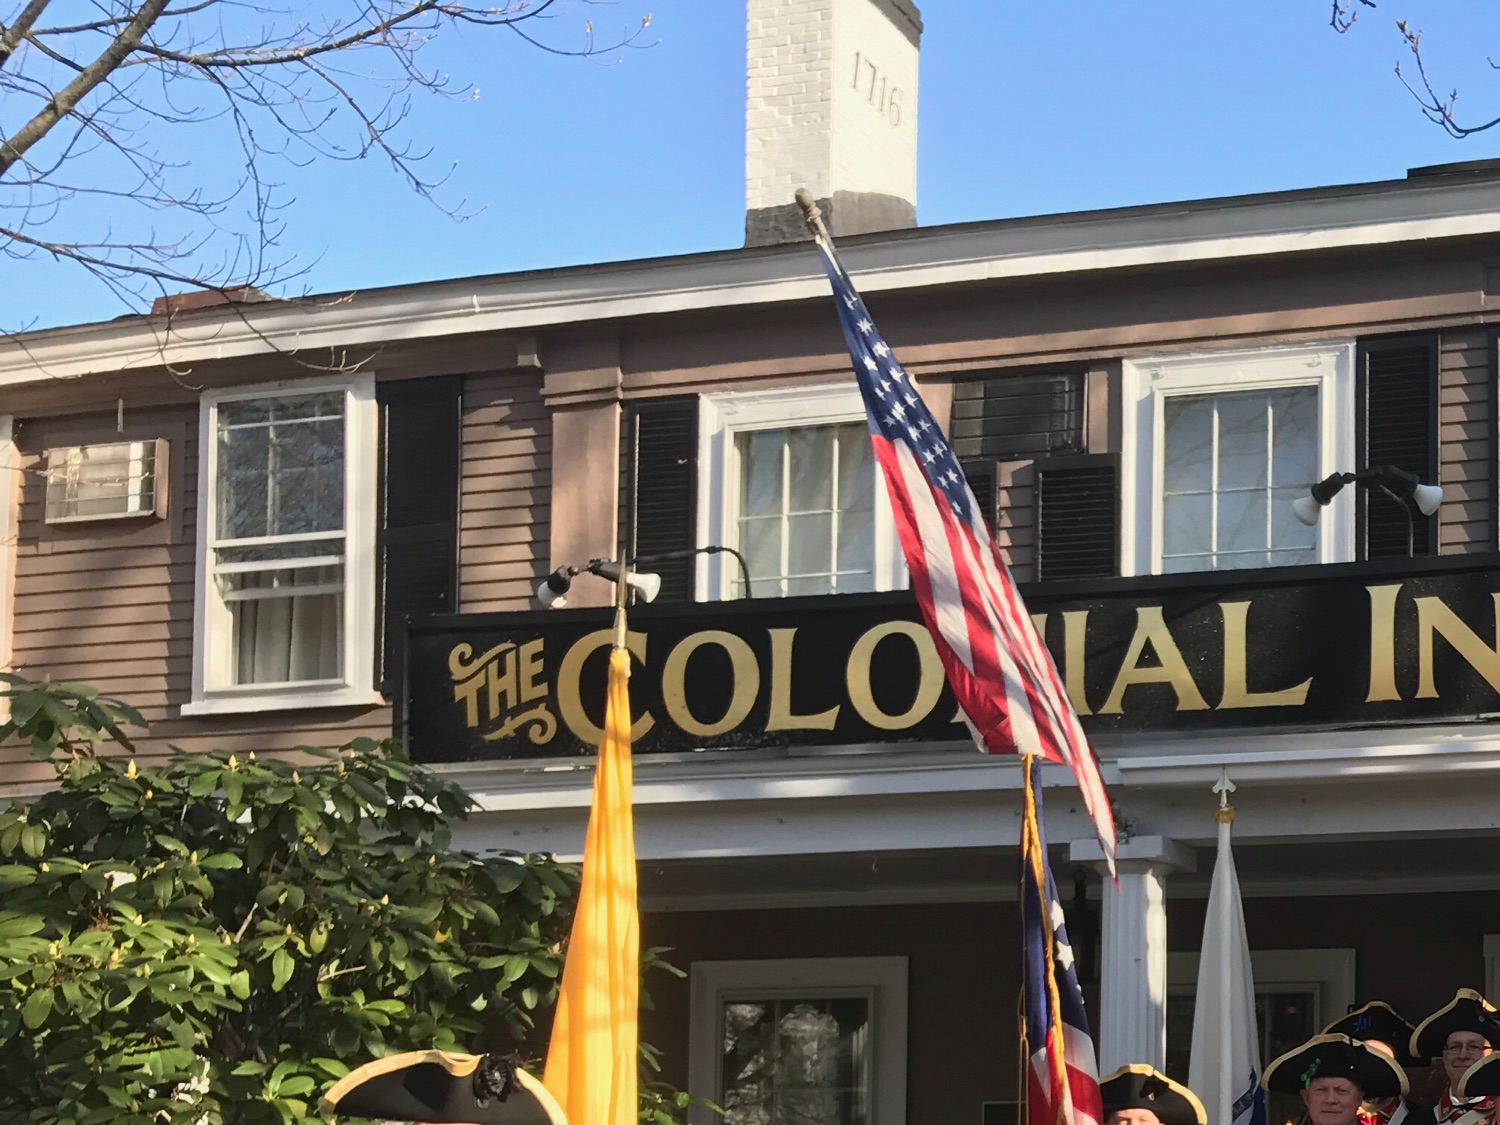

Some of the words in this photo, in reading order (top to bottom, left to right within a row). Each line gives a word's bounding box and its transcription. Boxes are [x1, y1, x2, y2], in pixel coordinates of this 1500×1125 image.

[852, 51, 901, 127] 1716
[453, 637, 549, 728] THE
[556, 600, 1313, 746] COLOIAL
